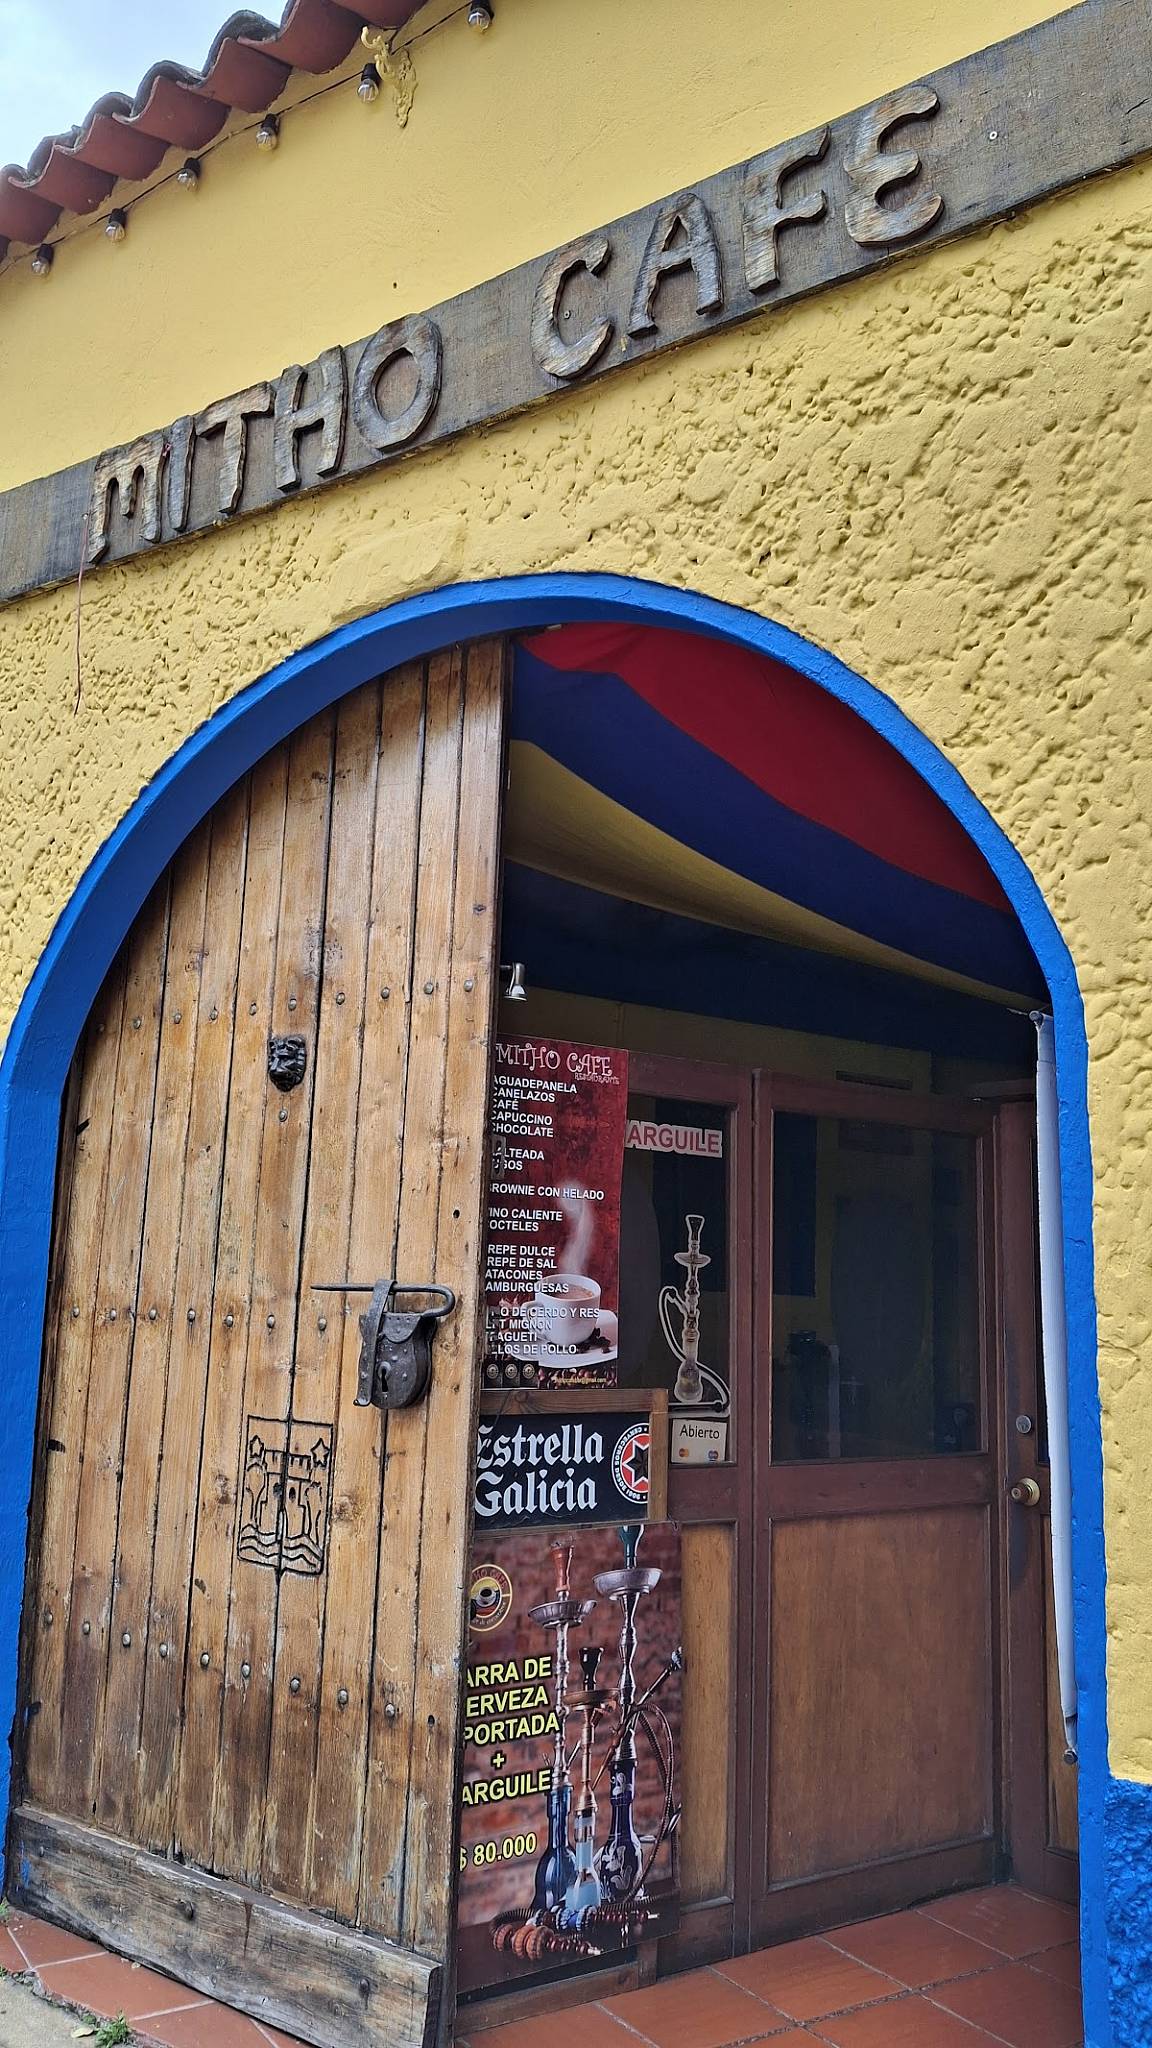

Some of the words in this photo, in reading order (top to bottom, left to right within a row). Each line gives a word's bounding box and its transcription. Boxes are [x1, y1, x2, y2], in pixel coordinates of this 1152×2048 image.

[89, 313, 443, 566] MITHO
[531, 85, 943, 380] CAFE
[496, 1043, 560, 1071] MITHO
[566, 1052, 612, 1076] CAFE
[627, 1125, 720, 1153] ARGUILE
[490, 1183, 535, 1195] ROWNIE
[537, 1187, 560, 1197] CON
[563, 1188, 605, 1200] HELADO
[488, 1207, 508, 1218] INO
[511, 1208, 563, 1221] CALIENTE
[489, 1219, 539, 1231] OCTELES
[487, 1244, 517, 1255] REPE
[520, 1245, 556, 1257] DULCE
[487, 1256, 516, 1267] REPE
[519, 1258, 534, 1268] DE
[536, 1258, 557, 1269] SAL
[485, 1268, 543, 1280] ATACONES
[485, 1281, 569, 1293] AMBURGUESAS
[512, 1306, 527, 1317] DE
[529, 1306, 567, 1317] CERDO
[569, 1307, 577, 1317] Y
[579, 1307, 600, 1318] RES
[509, 1319, 553, 1329] MIGNON
[523, 1344, 538, 1354] DE
[541, 1344, 577, 1354] POLLO
[680, 1424, 720, 1440] Abierto
[477, 1424, 604, 1469] Estrella
[475, 1468, 598, 1517] Galicia
[467, 1661, 519, 1688] ARRA
[524, 1656, 552, 1680] DE
[466, 1685, 549, 1718] ERVEZA
[464, 1712, 560, 1745] PORTADA
[462, 1769, 551, 1805] ARGUILE
[473, 1832, 537, 1866] 80.000
